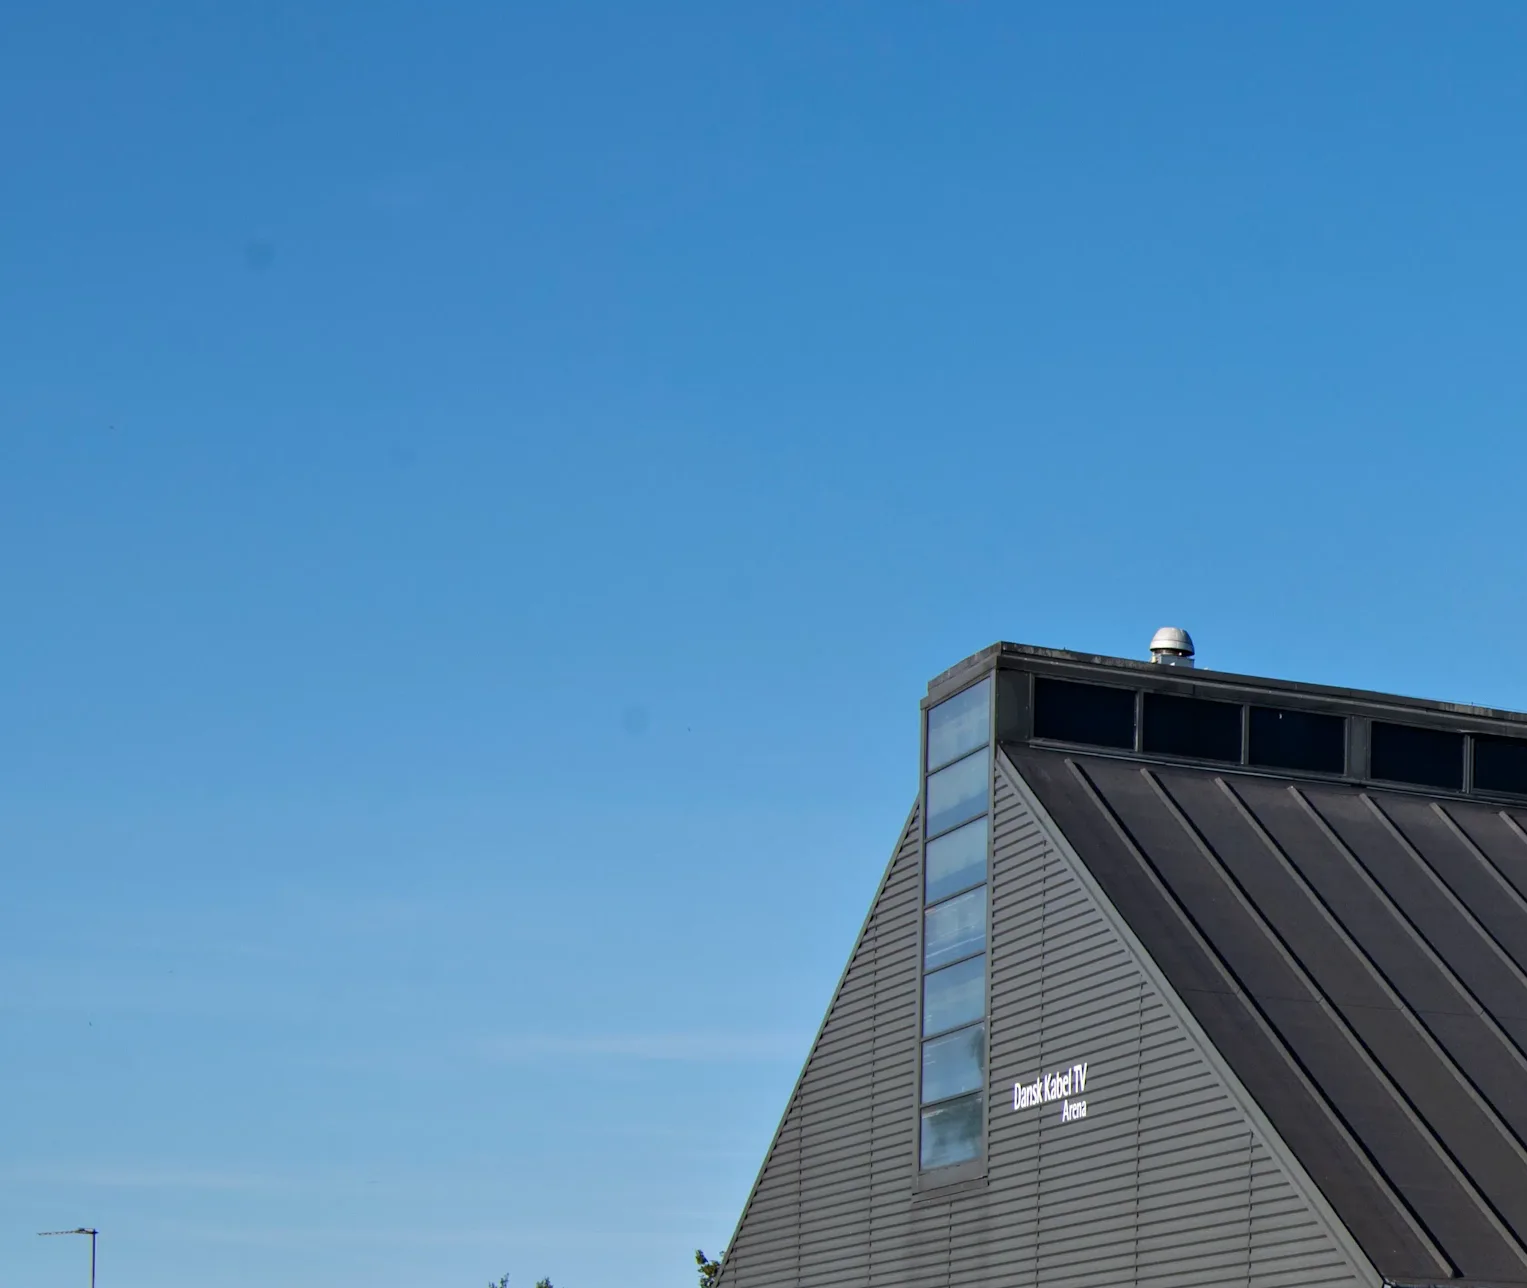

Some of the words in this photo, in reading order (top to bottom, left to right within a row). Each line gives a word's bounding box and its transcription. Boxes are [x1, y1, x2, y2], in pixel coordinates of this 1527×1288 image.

[1013, 1077, 1043, 1110] Dansk
[1044, 1067, 1072, 1102] Kabel
[1073, 1062, 1088, 1094] TV
[1062, 1099, 1087, 1122] Arena
